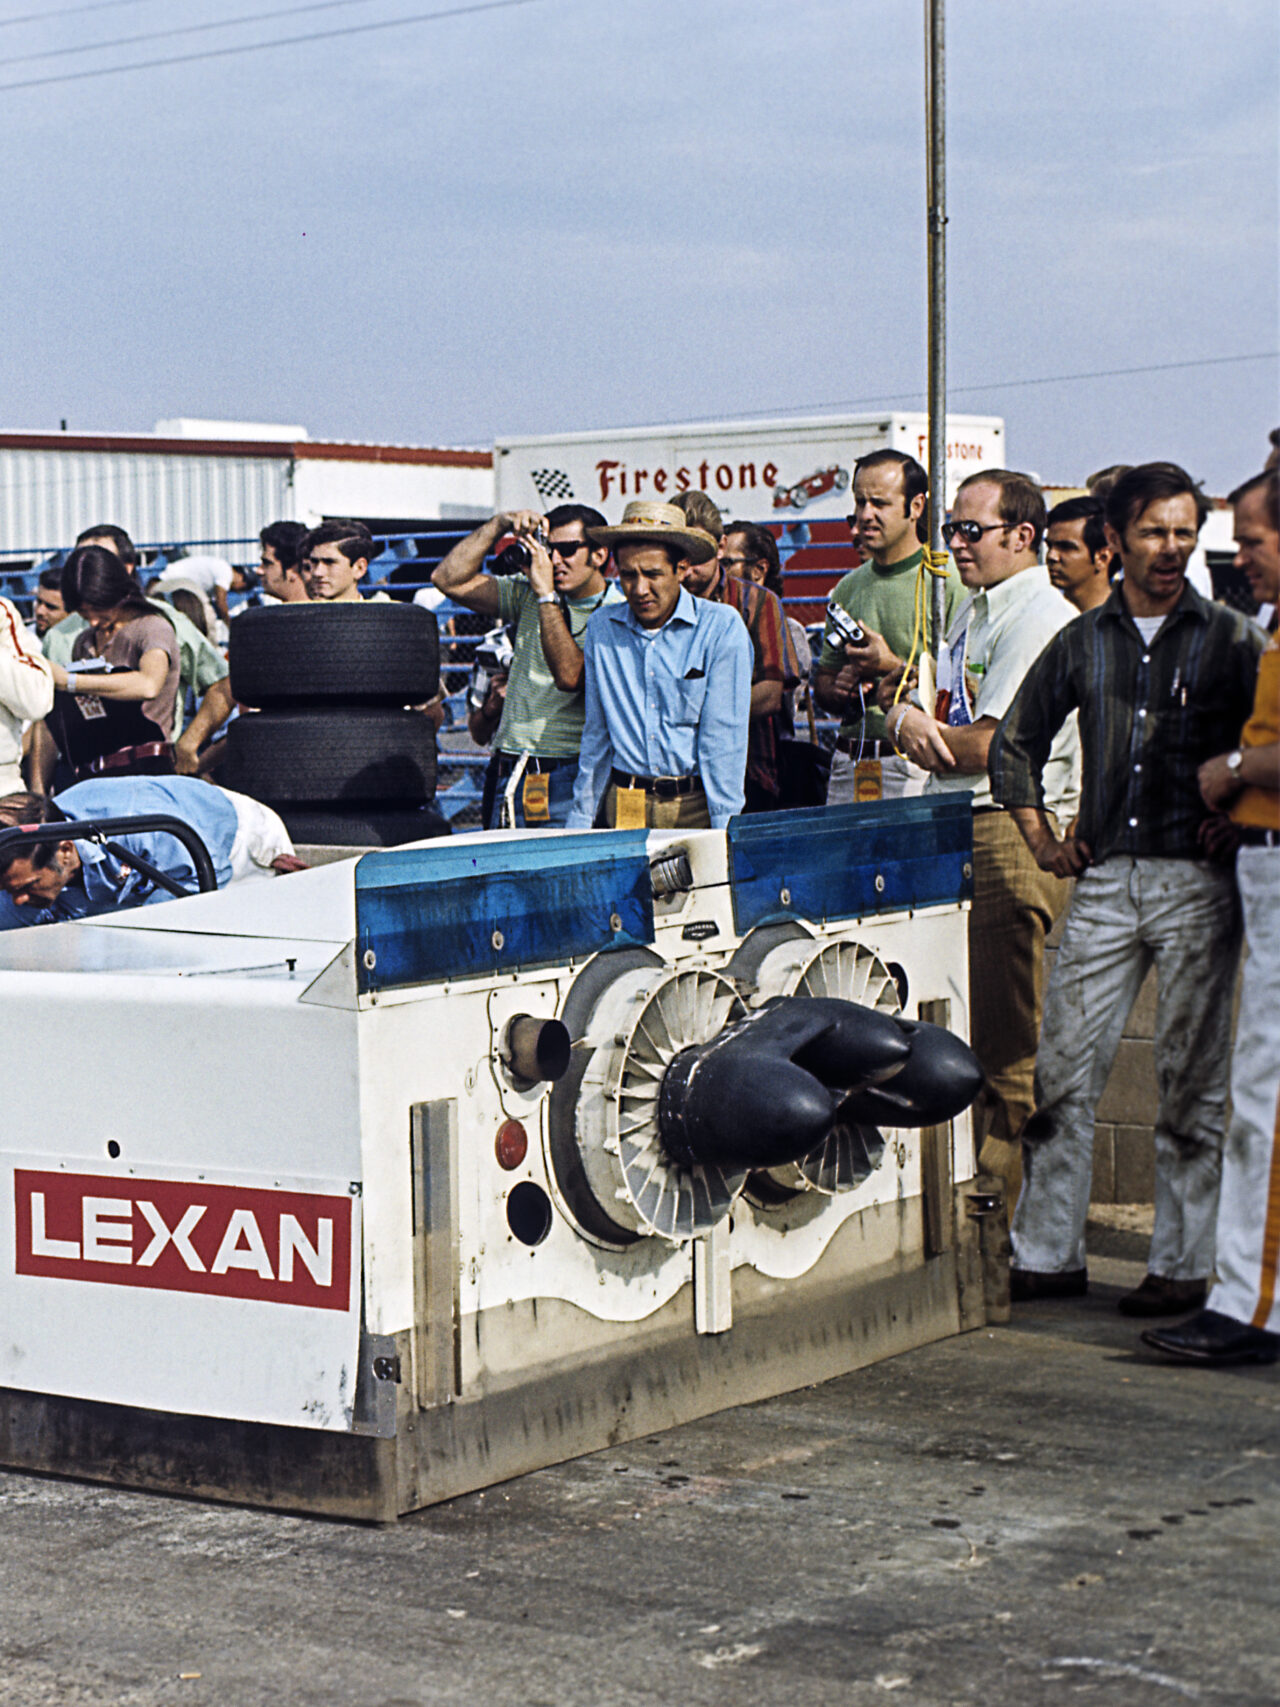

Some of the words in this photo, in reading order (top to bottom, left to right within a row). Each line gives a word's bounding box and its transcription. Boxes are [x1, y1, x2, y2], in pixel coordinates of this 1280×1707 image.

[917, 434, 983, 461] Fstone
[595, 458, 779, 502] Firestone
[30, 1192, 334, 1287] LEXAN
